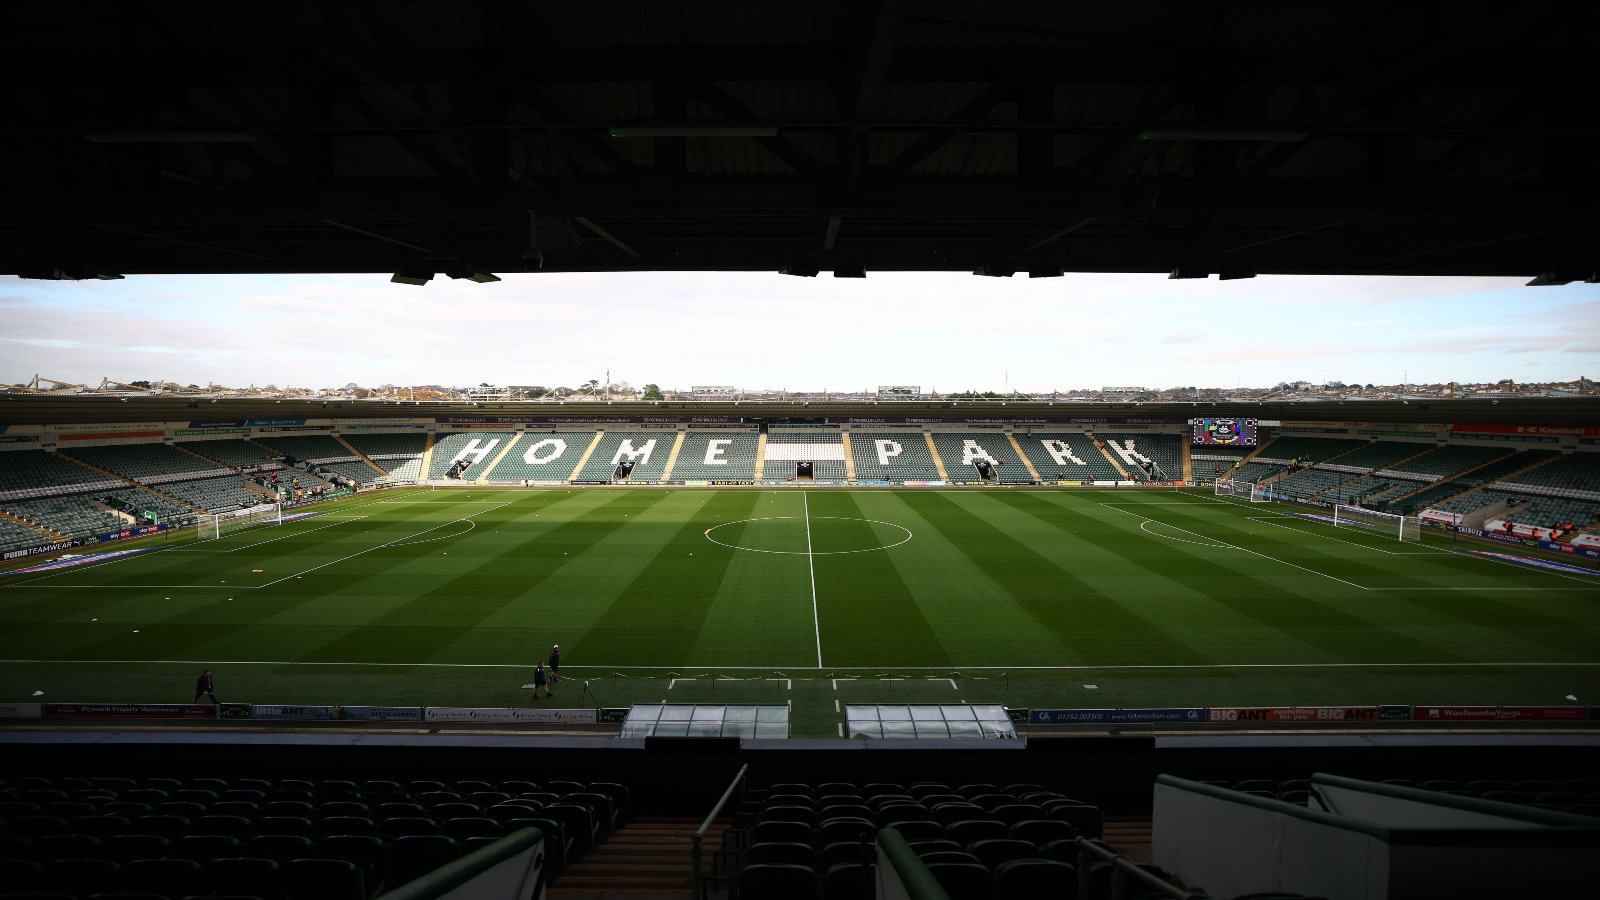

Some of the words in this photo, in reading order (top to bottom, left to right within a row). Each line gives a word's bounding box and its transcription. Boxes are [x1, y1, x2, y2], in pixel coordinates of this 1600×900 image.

[139, 526, 149, 534] sky
[1458, 526, 1484, 537] TRIBUTE
[110, 532, 120, 540] sky
[28, 541, 73, 555] TEAMWEAR
[1549, 542, 1561, 552] sky
[1561, 544, 1574, 553] bet
[1273, 708, 1314, 716] recruiting
